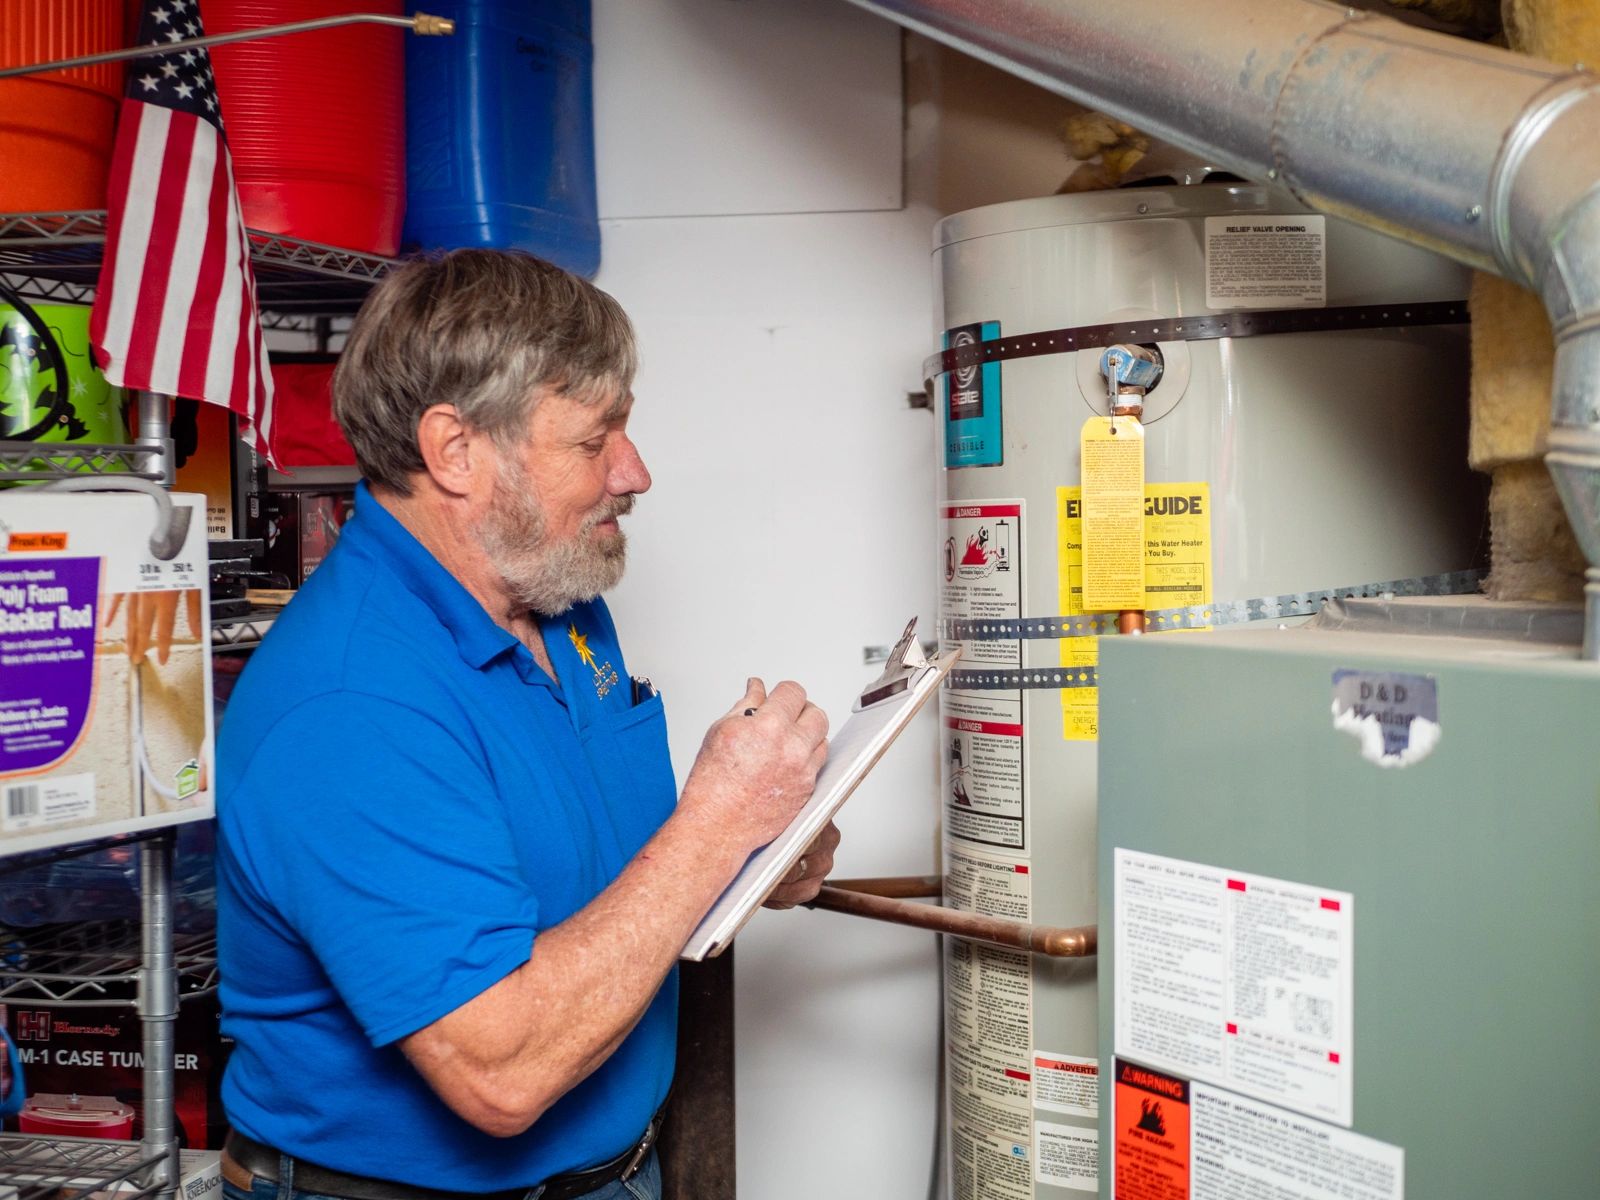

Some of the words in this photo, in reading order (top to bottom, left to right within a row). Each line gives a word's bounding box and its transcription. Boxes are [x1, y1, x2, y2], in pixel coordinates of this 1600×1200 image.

[960, 508, 981, 517] DANGER
[1360, 681, 1373, 700] D
[1377, 683, 1388, 702] &
[1394, 684, 1408, 703] D
[53, 1021, 120, 1037] Hornady
[18, 1048, 49, 1065] M-1
[55, 1049, 105, 1067] CASE
[1060, 1063, 1099, 1075] ADVERTE
[1132, 1070, 1183, 1098] WARNING
